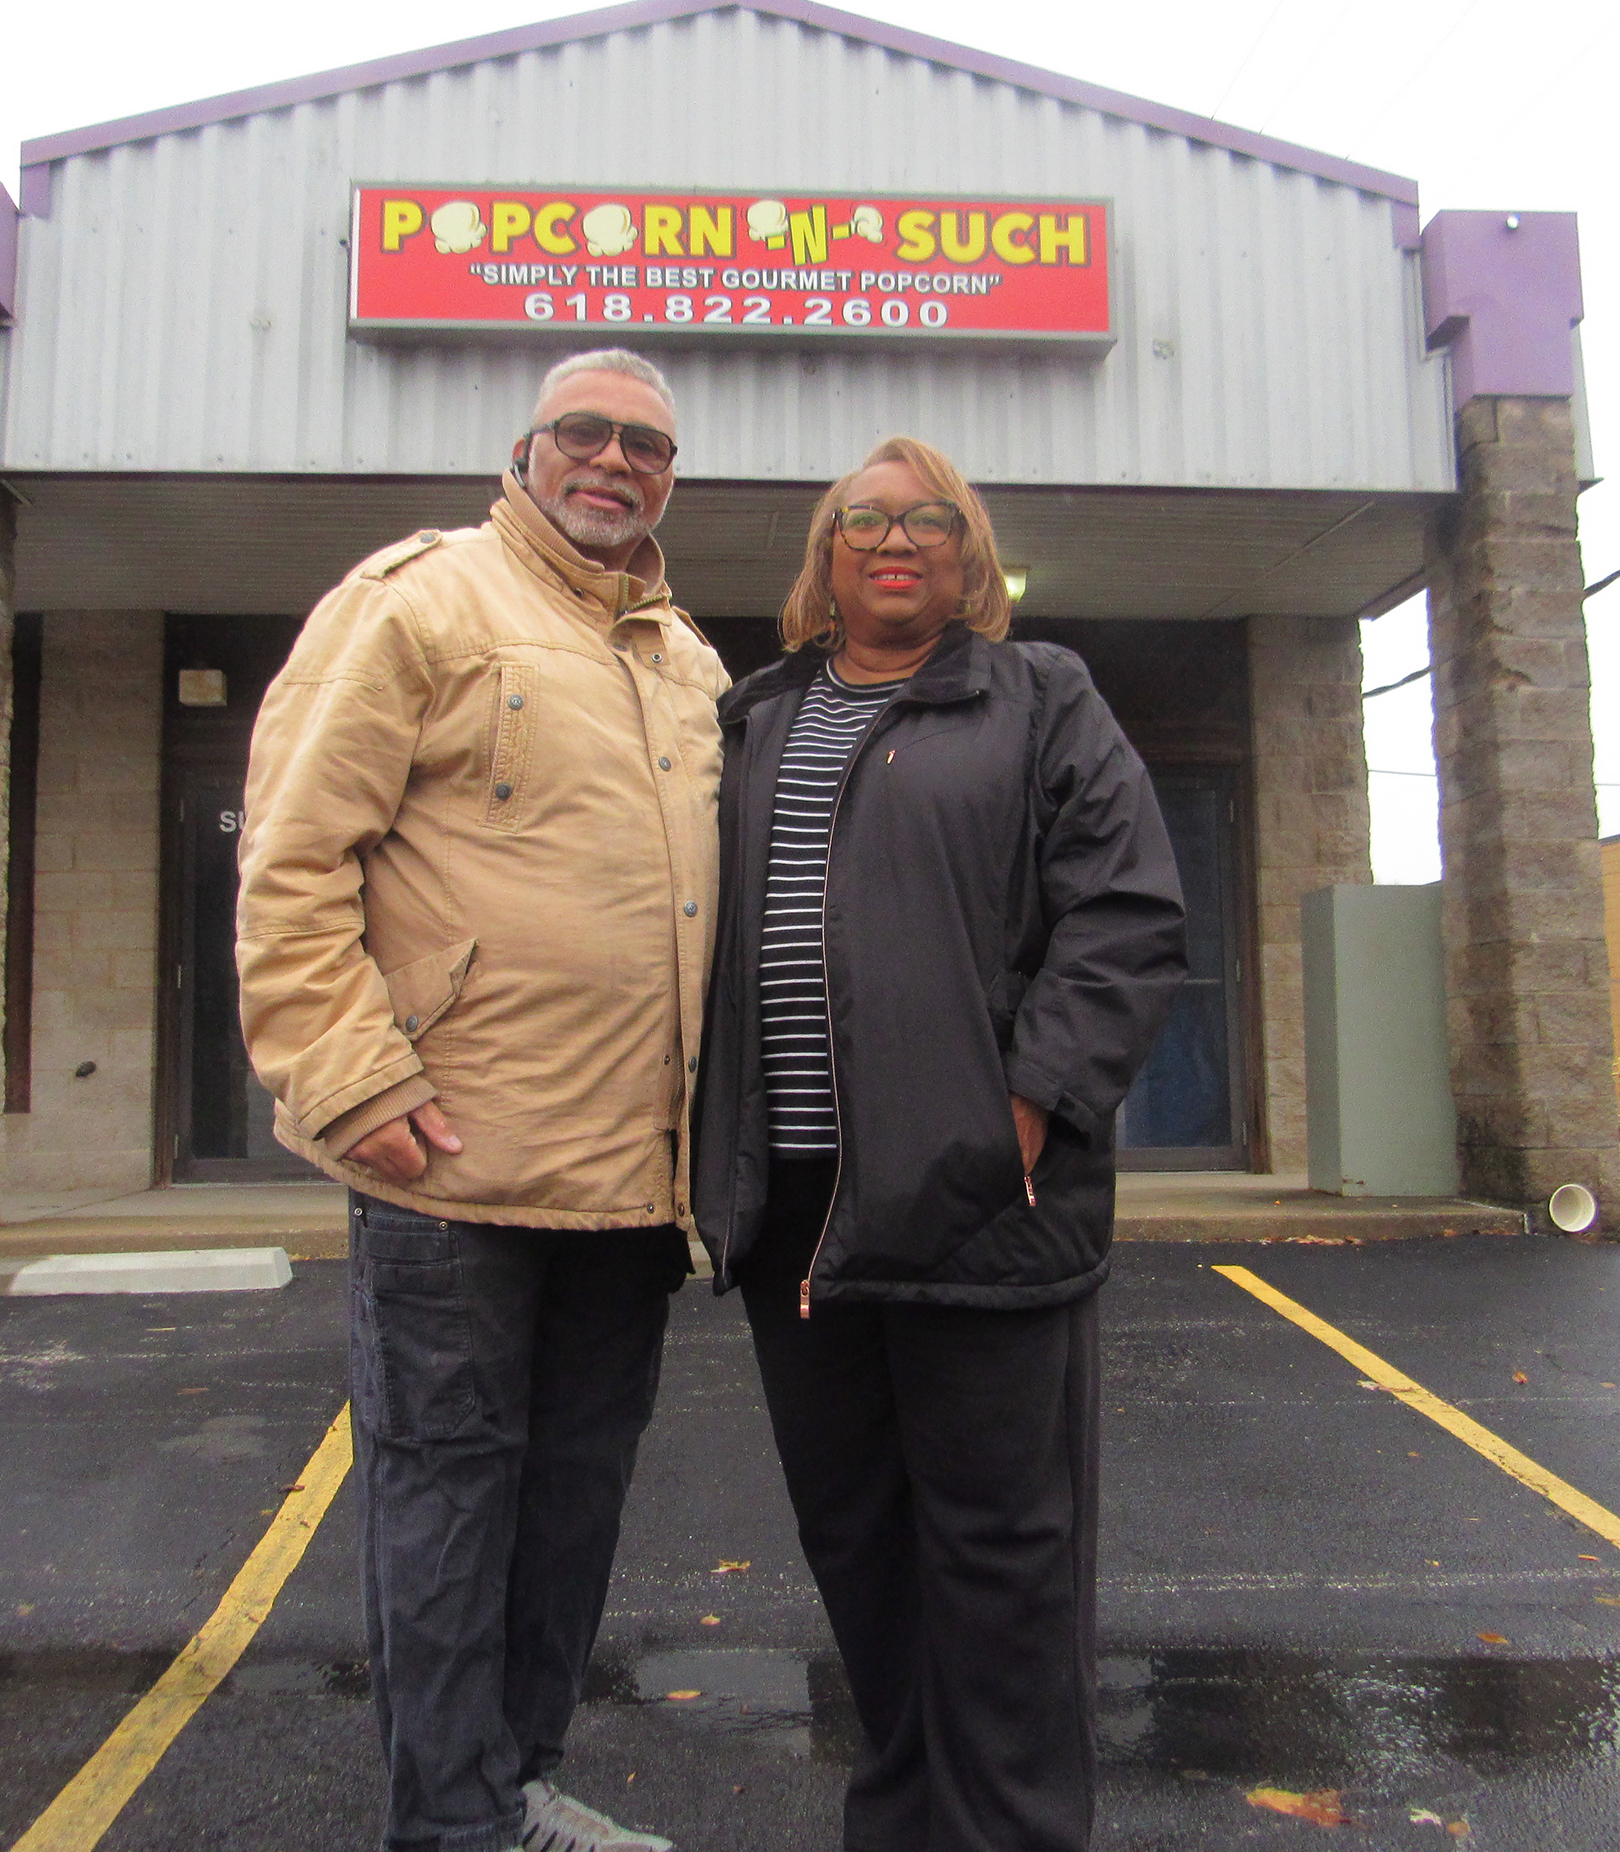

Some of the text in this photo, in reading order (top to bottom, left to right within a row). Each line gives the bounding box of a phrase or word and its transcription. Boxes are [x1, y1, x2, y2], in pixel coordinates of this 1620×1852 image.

[896, 208, 1087, 264] SUCH
[585, 265, 639, 287] THE
[645, 266, 715, 288] BEST
[721, 268, 853, 292] GOURMET
[524, 291, 949, 328] 618.822.2600
